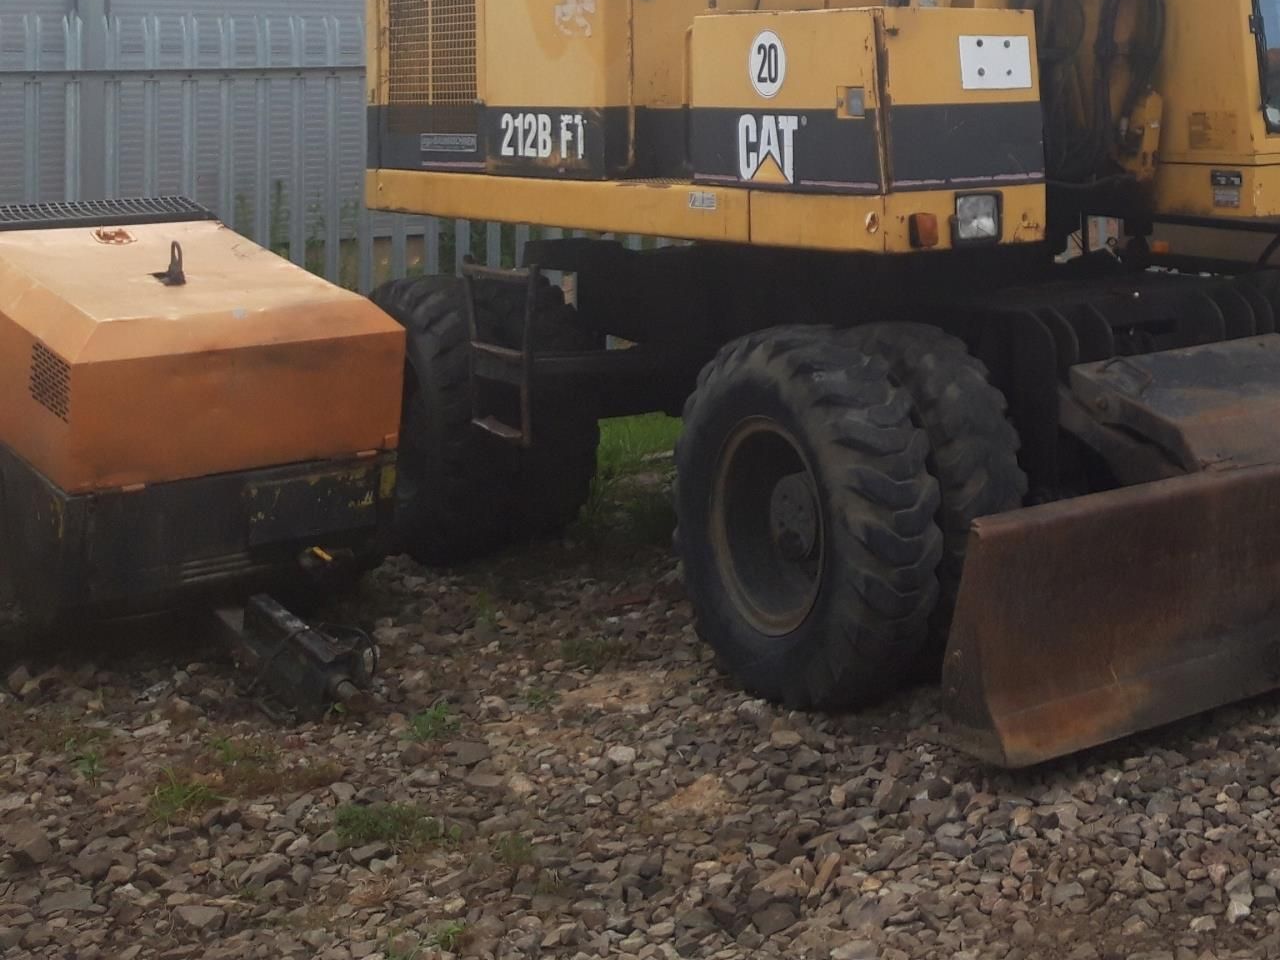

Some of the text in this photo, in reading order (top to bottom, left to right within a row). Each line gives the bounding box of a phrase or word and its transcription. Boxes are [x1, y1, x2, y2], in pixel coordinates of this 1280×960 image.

[757, 43, 779, 83] 20
[501, 113, 552, 158] 212B
[738, 113, 798, 184] CAT
